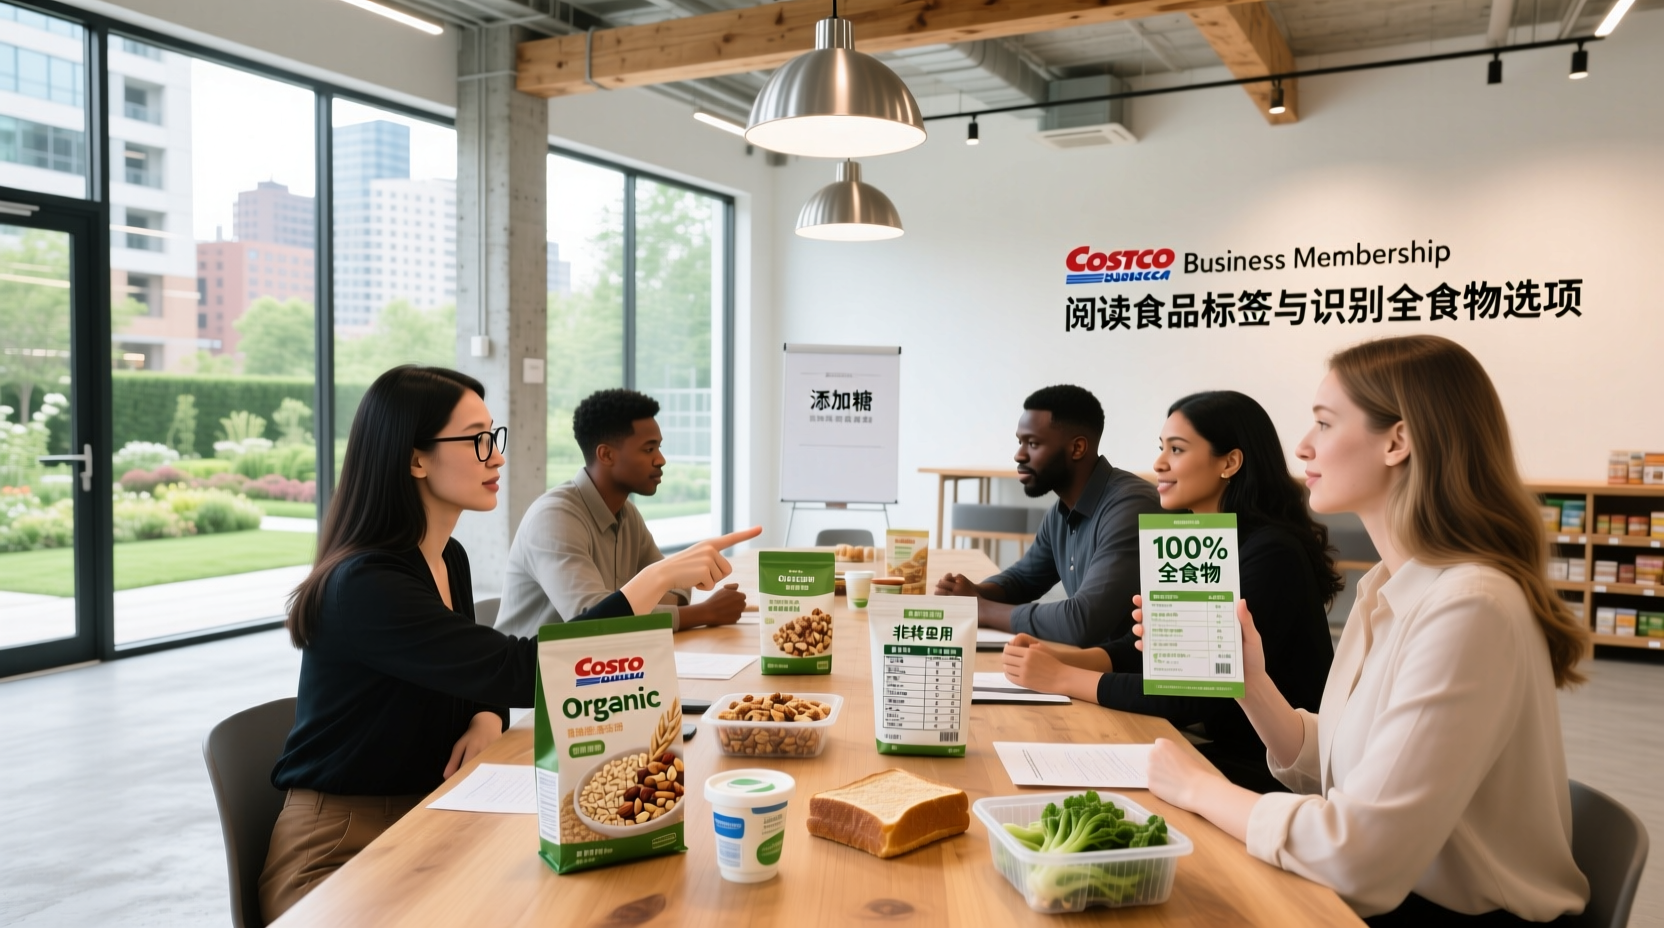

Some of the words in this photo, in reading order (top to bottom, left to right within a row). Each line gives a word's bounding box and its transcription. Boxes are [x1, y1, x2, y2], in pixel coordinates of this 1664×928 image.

[1184, 250, 1286, 274] Business
[1294, 239, 1451, 269] Membership
[1065, 279, 1583, 332] 阅读食品标签与识别全食物选项
[810, 389, 873, 412] 添加糖
[1153, 535, 1228, 560] 100%
[1158, 561, 1221, 584] 全食物
[562, 686, 662, 722] Organic
